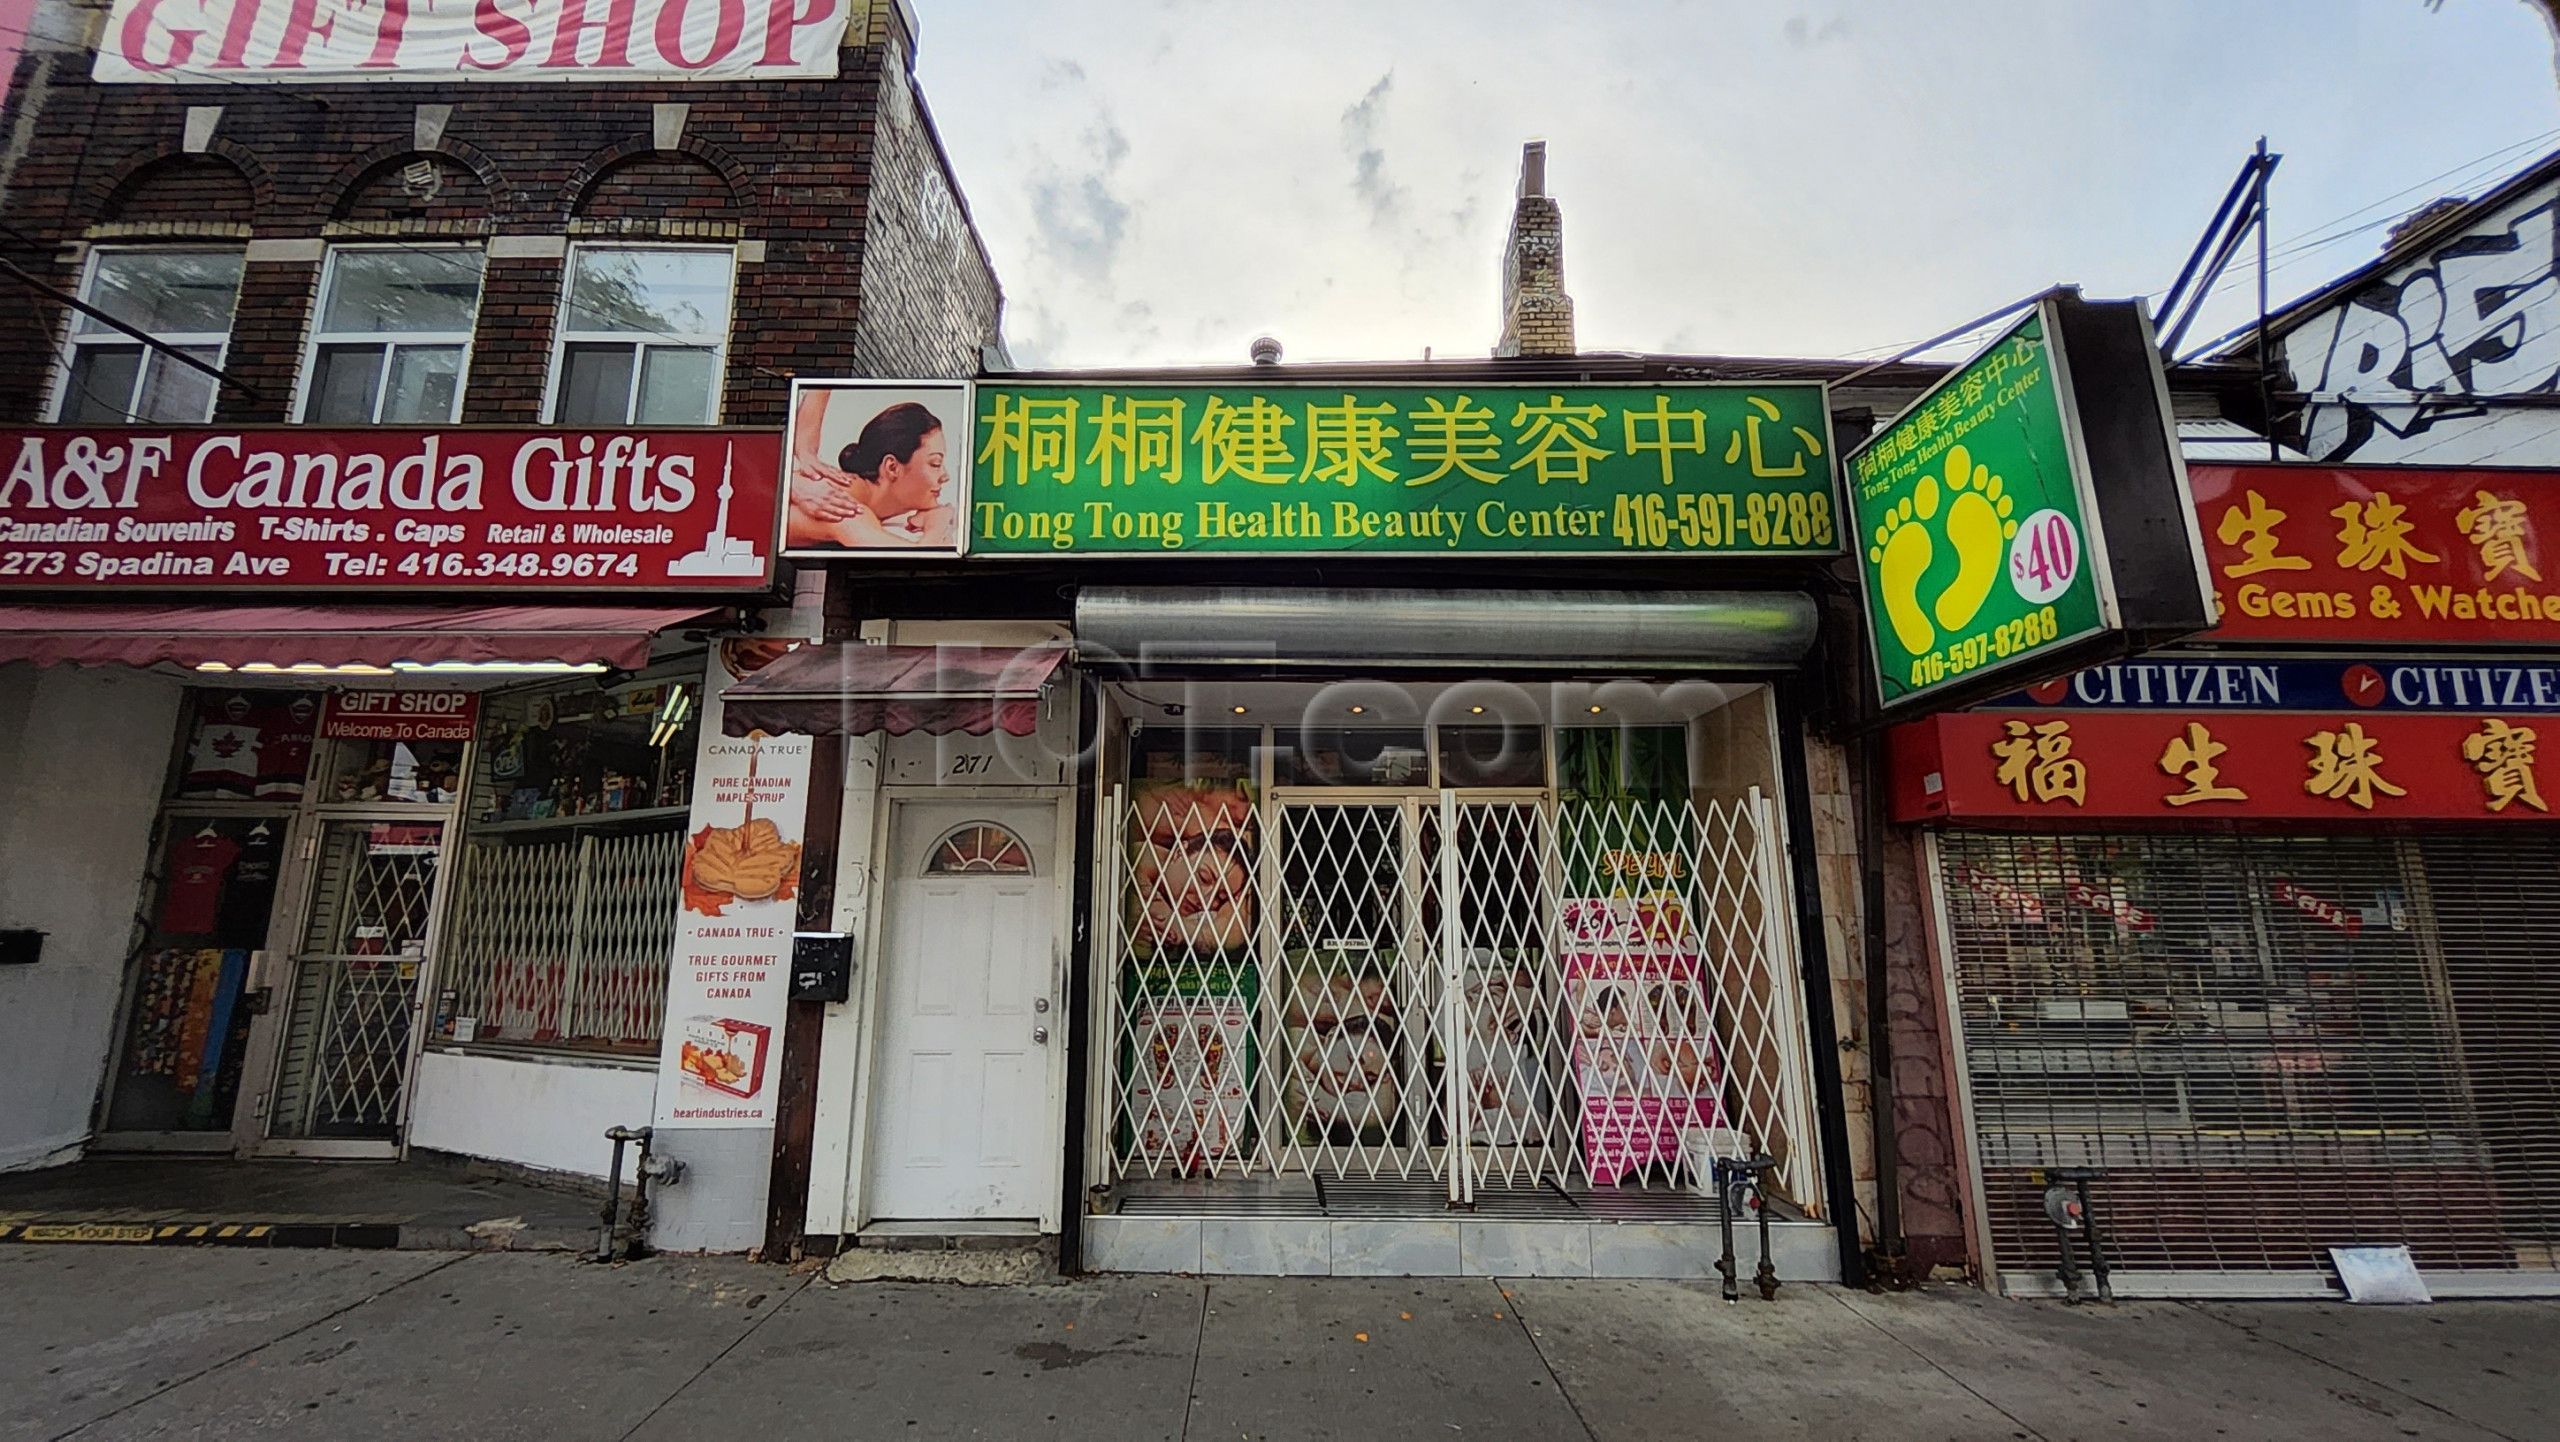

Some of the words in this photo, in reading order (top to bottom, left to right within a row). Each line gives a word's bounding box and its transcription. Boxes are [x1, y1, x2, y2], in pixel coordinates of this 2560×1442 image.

[121, 0, 433, 73] GIFT
[456, 0, 837, 71] SHOP
[1857, 336, 2044, 485] 桐桐健康美容中心
[977, 394, 1822, 487] 桐桐健康美容中心
[1863, 481, 1890, 500] Tong
[1889, 459, 1917, 484] Tong
[1917, 432, 1954, 465] Health
[1953, 402, 1996, 438] Beauty
[1997, 367, 2041, 407] Center
[0, 435, 172, 510] A&F
[187, 434, 484, 512] Canada
[511, 435, 696, 513] Gifts
[0, 516, 110, 543] Canadian
[115, 516, 236, 543] Souvenirs
[259, 516, 370, 542] T-Shirts
[394, 518, 466, 548] Caps
[486, 523, 547, 544] Retail
[551, 524, 566, 544] &
[572, 523, 674, 545] Wholesale
[976, 501, 1075, 546] Tong
[1083, 501, 1183, 548] Tong
[1195, 501, 1323, 538] Health
[1331, 501, 1465, 548] Beauty
[1476, 502, 1606, 538] Center
[1612, 492, 1834, 547] 416-597-8288
[2215, 488, 2543, 583] 生珠寶
[0, 552, 66, 576] 273
[74, 551, 214, 581] Spadina
[223, 552, 291, 576] Ave
[324, 552, 388, 576] Tel:
[397, 552, 639, 578] 416.348.9674
[2014, 514, 2074, 593] $40
[2237, 583, 2357, 619] Gems
[2369, 585, 2402, 619] &
[1911, 605, 2058, 687] 416-597-8288
[2075, 665, 2280, 705] CITIZEN
[2391, 667, 2560, 706] CITIZE
[341, 692, 396, 712] GIFT
[400, 692, 467, 713] SHOP
[327, 720, 393, 738] Welcome
[396, 722, 412, 738] To
[416, 723, 470, 739] Canada
[708, 744, 766, 755] CANADA
[770, 744, 803, 755] TRUE
[952, 753, 993, 775] 271
[1991, 718, 2549, 813] 福生珠寶
[712, 777, 740, 788] PURE
[742, 777, 792, 788] CANADIAN
[716, 792, 750, 803] MAPLE
[752, 792, 785, 803] SYRUP
[697, 927, 741, 938] CANADA
[746, 927, 774, 938] TRUE
[688, 955, 717, 966] TRUE
[721, 955, 778, 966] GOURMET
[696, 971, 730, 982] GIFTS
[733, 971, 766, 982] FROM
[706, 988, 752, 999] CANADA
[673, 1107, 763, 1119] heartindustries.ca
